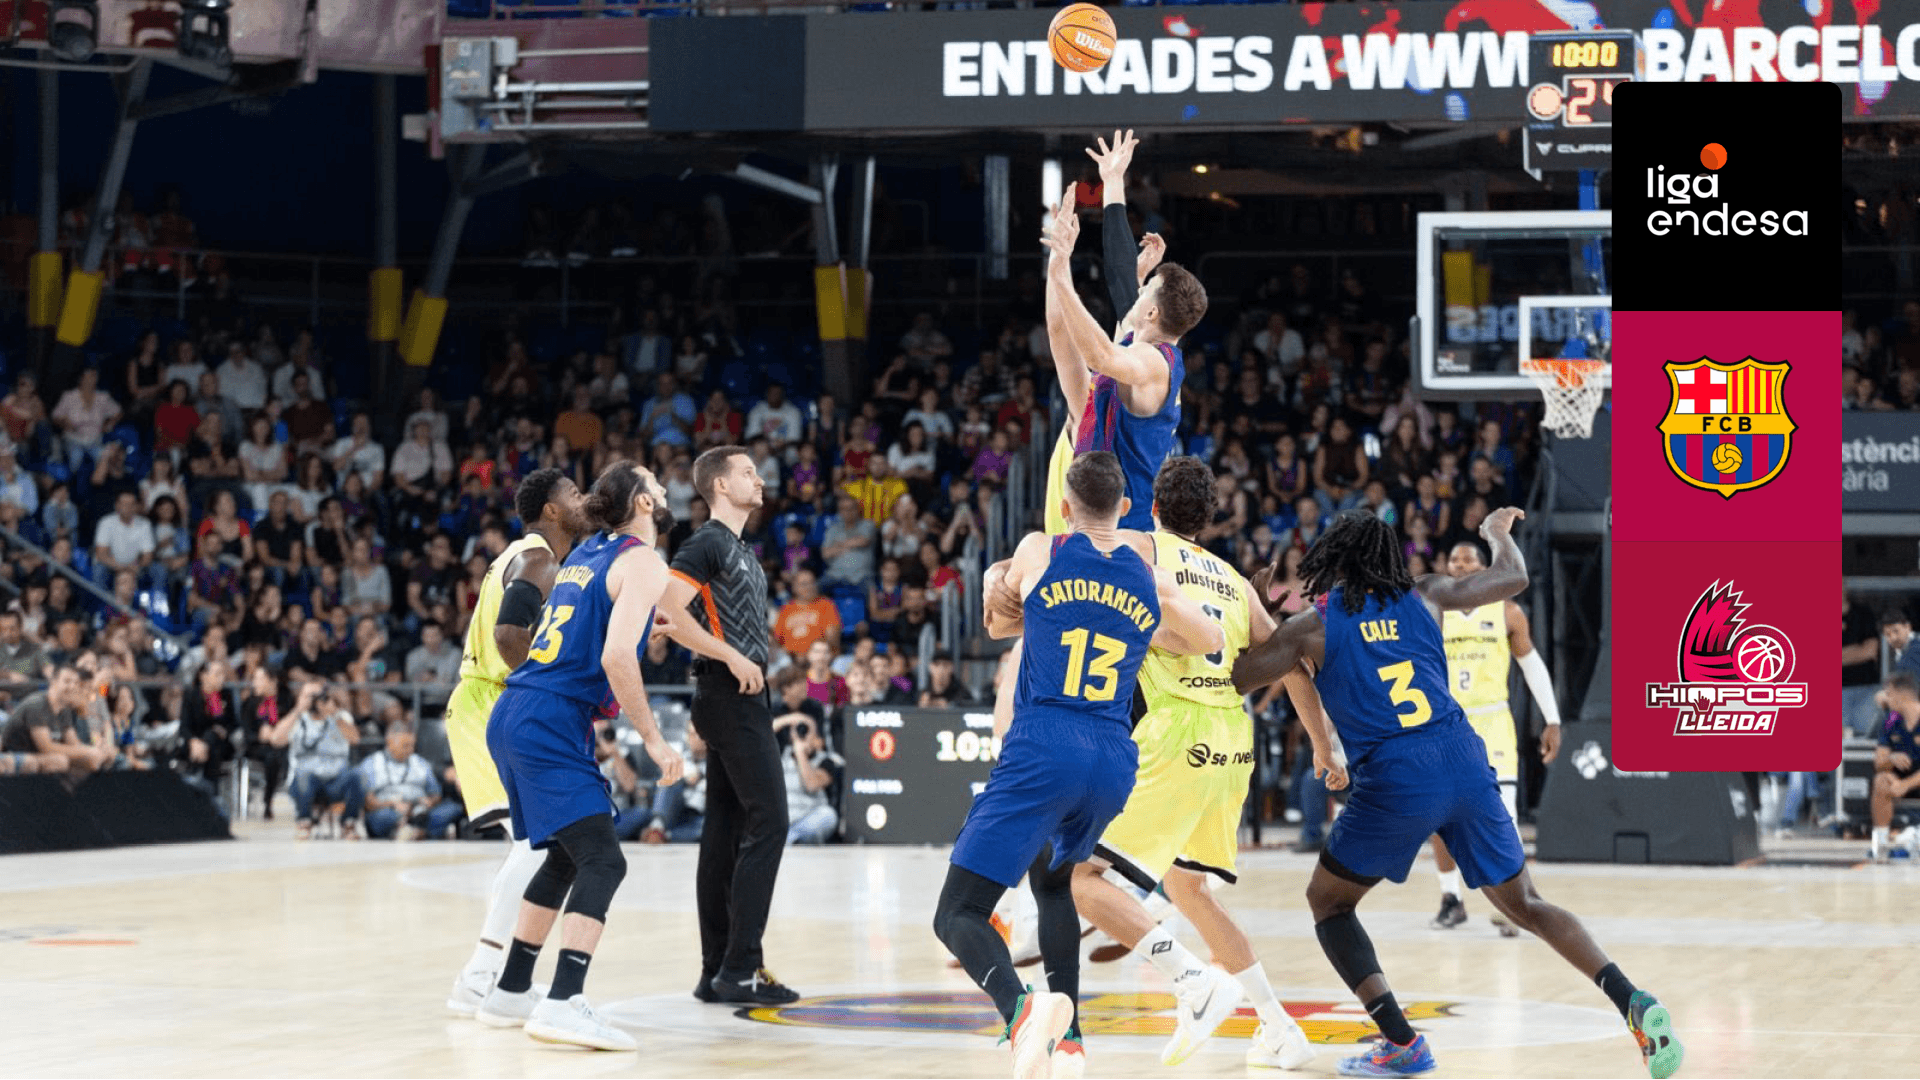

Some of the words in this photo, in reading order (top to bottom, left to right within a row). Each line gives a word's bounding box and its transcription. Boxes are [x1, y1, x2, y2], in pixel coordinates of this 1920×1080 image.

[1284, 35, 1332, 91] A
[1553, 41, 1618, 67] 10:00
[1040, 578, 1155, 632] SATORANSKY
[1359, 619, 1399, 643] CALE
[1060, 627, 1128, 701] 13
[1459, 671, 1470, 690] 2
[1377, 659, 1433, 728] 3
[869, 729, 895, 760] 0
